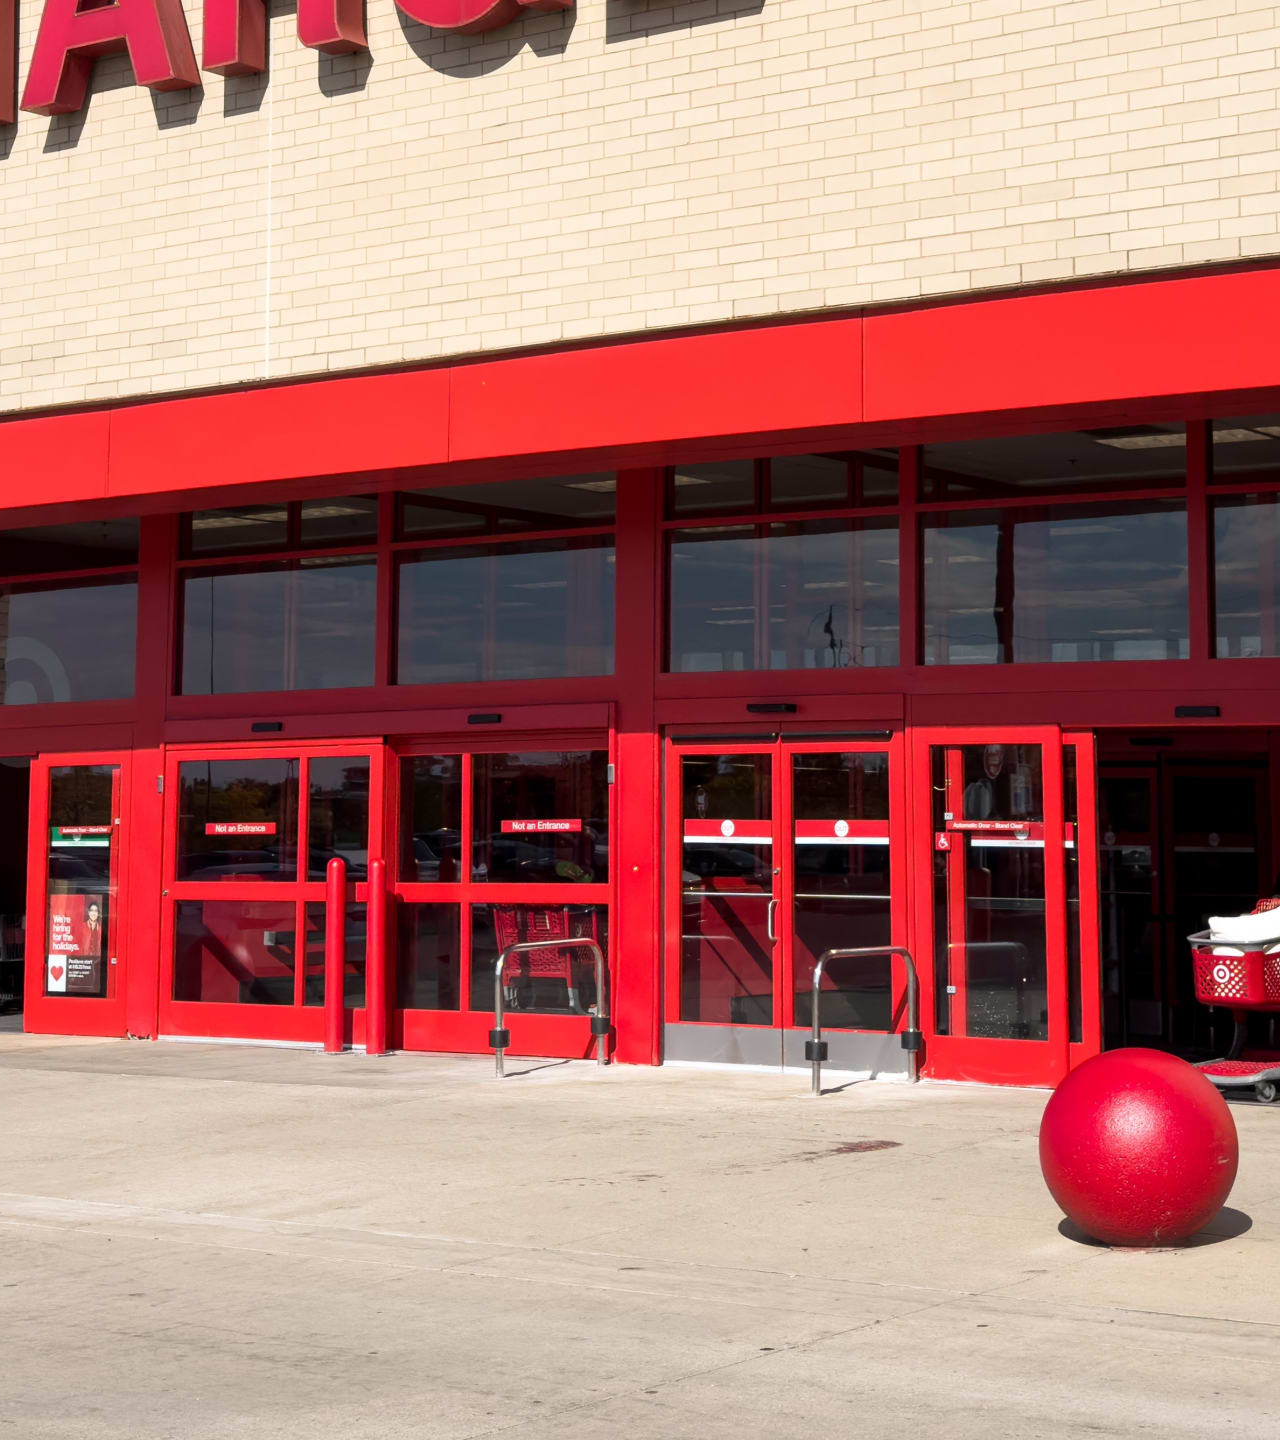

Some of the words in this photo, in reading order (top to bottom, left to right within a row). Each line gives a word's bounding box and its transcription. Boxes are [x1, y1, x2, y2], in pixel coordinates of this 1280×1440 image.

[215, 824, 226, 832] Not
[237, 824, 266, 832] Entrance
[511, 821, 525, 830] Not
[537, 820, 570, 830] Entrance
[53, 915, 72, 923] We're
[52, 924, 71, 935] hiring
[52, 933, 62, 941] for
[62, 933, 74, 941] the
[52, 942, 80, 953] holidays.
